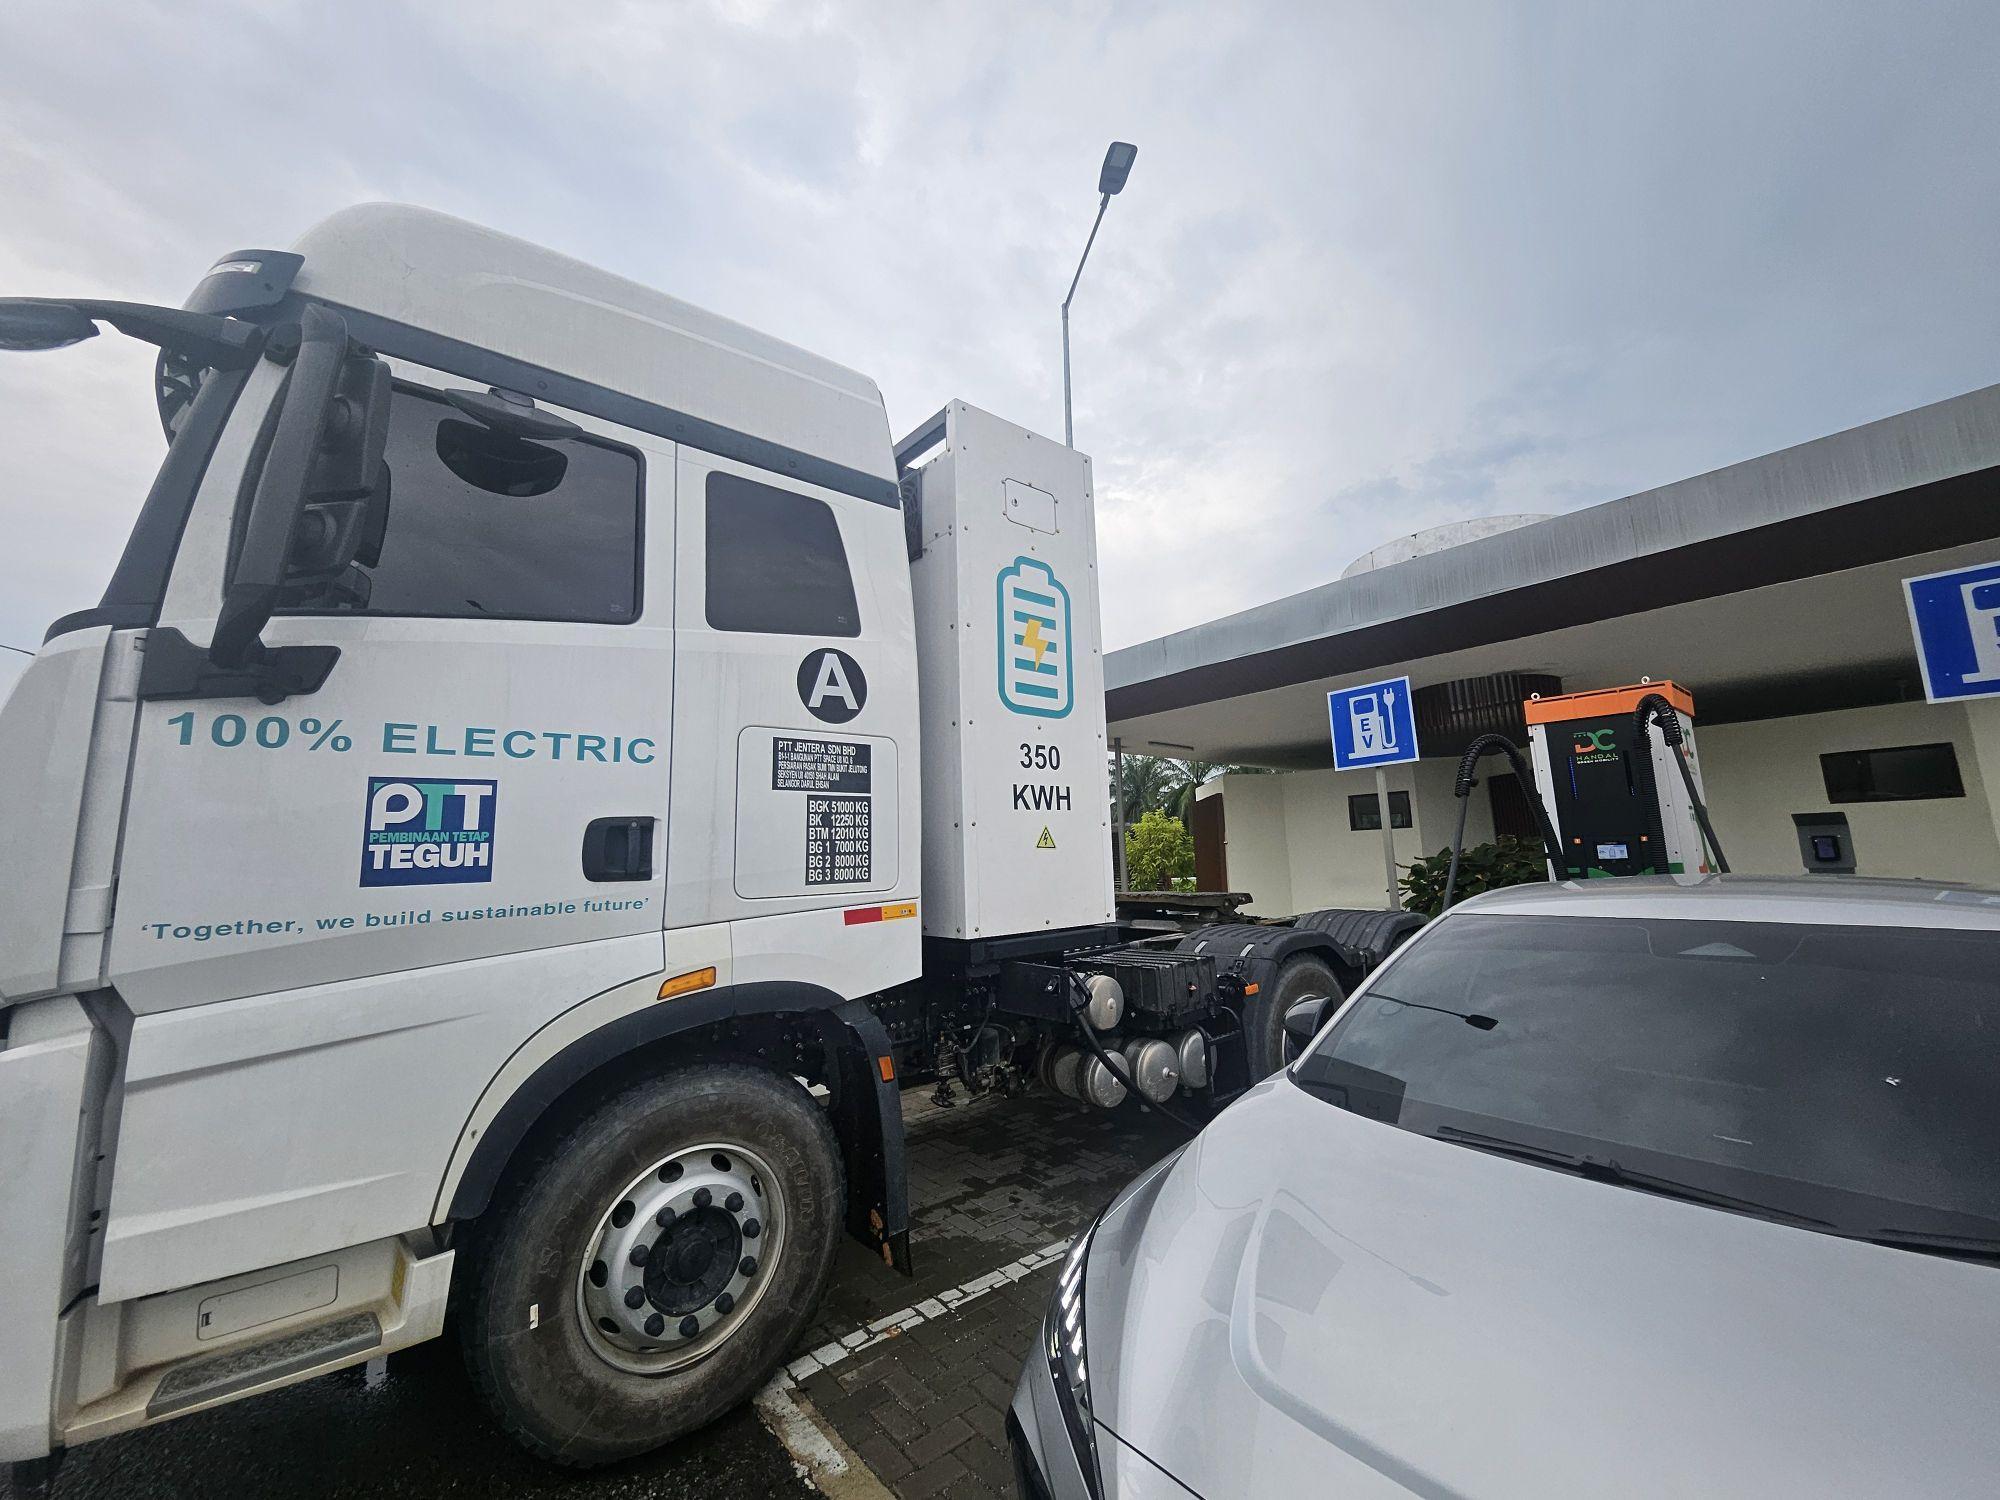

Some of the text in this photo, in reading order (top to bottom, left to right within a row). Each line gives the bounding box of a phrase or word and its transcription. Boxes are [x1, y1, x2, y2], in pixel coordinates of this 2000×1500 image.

[808, 653, 859, 710] A
[168, 712, 655, 764] 100% ELECTRIC
[1360, 717, 1373, 749] EV
[778, 741, 856, 756] PTT JENTERA SDN BHD
[814, 754, 822, 762] PTT
[1020, 743, 1060, 770] 350
[1576, 753, 1618, 761] HANDAL
[777, 779, 800, 788] SELANGOR
[828, 773, 840, 781] ALAM
[1012, 784, 1071, 810] KWH
[370, 783, 492, 830] PTT
[810, 800, 868, 813] BGK 51000 KG
[810, 814, 868, 826] BK 12250 KG
[370, 832, 490, 843] PEMBINAAN TETAP
[809, 827, 868, 839] BTM 12010 KG
[809, 840, 868, 853] BG 1 7000 KG
[368, 843, 489, 870] TEGUH
[809, 854, 868, 867] BG 2 8000 KG
[809, 868, 868, 881] BG 3 8000 KG
[316, 917, 355, 930] we
[365, 910, 431, 928] build
[441, 902, 576, 922] sustainable
[584, 898, 649, 912] future’
